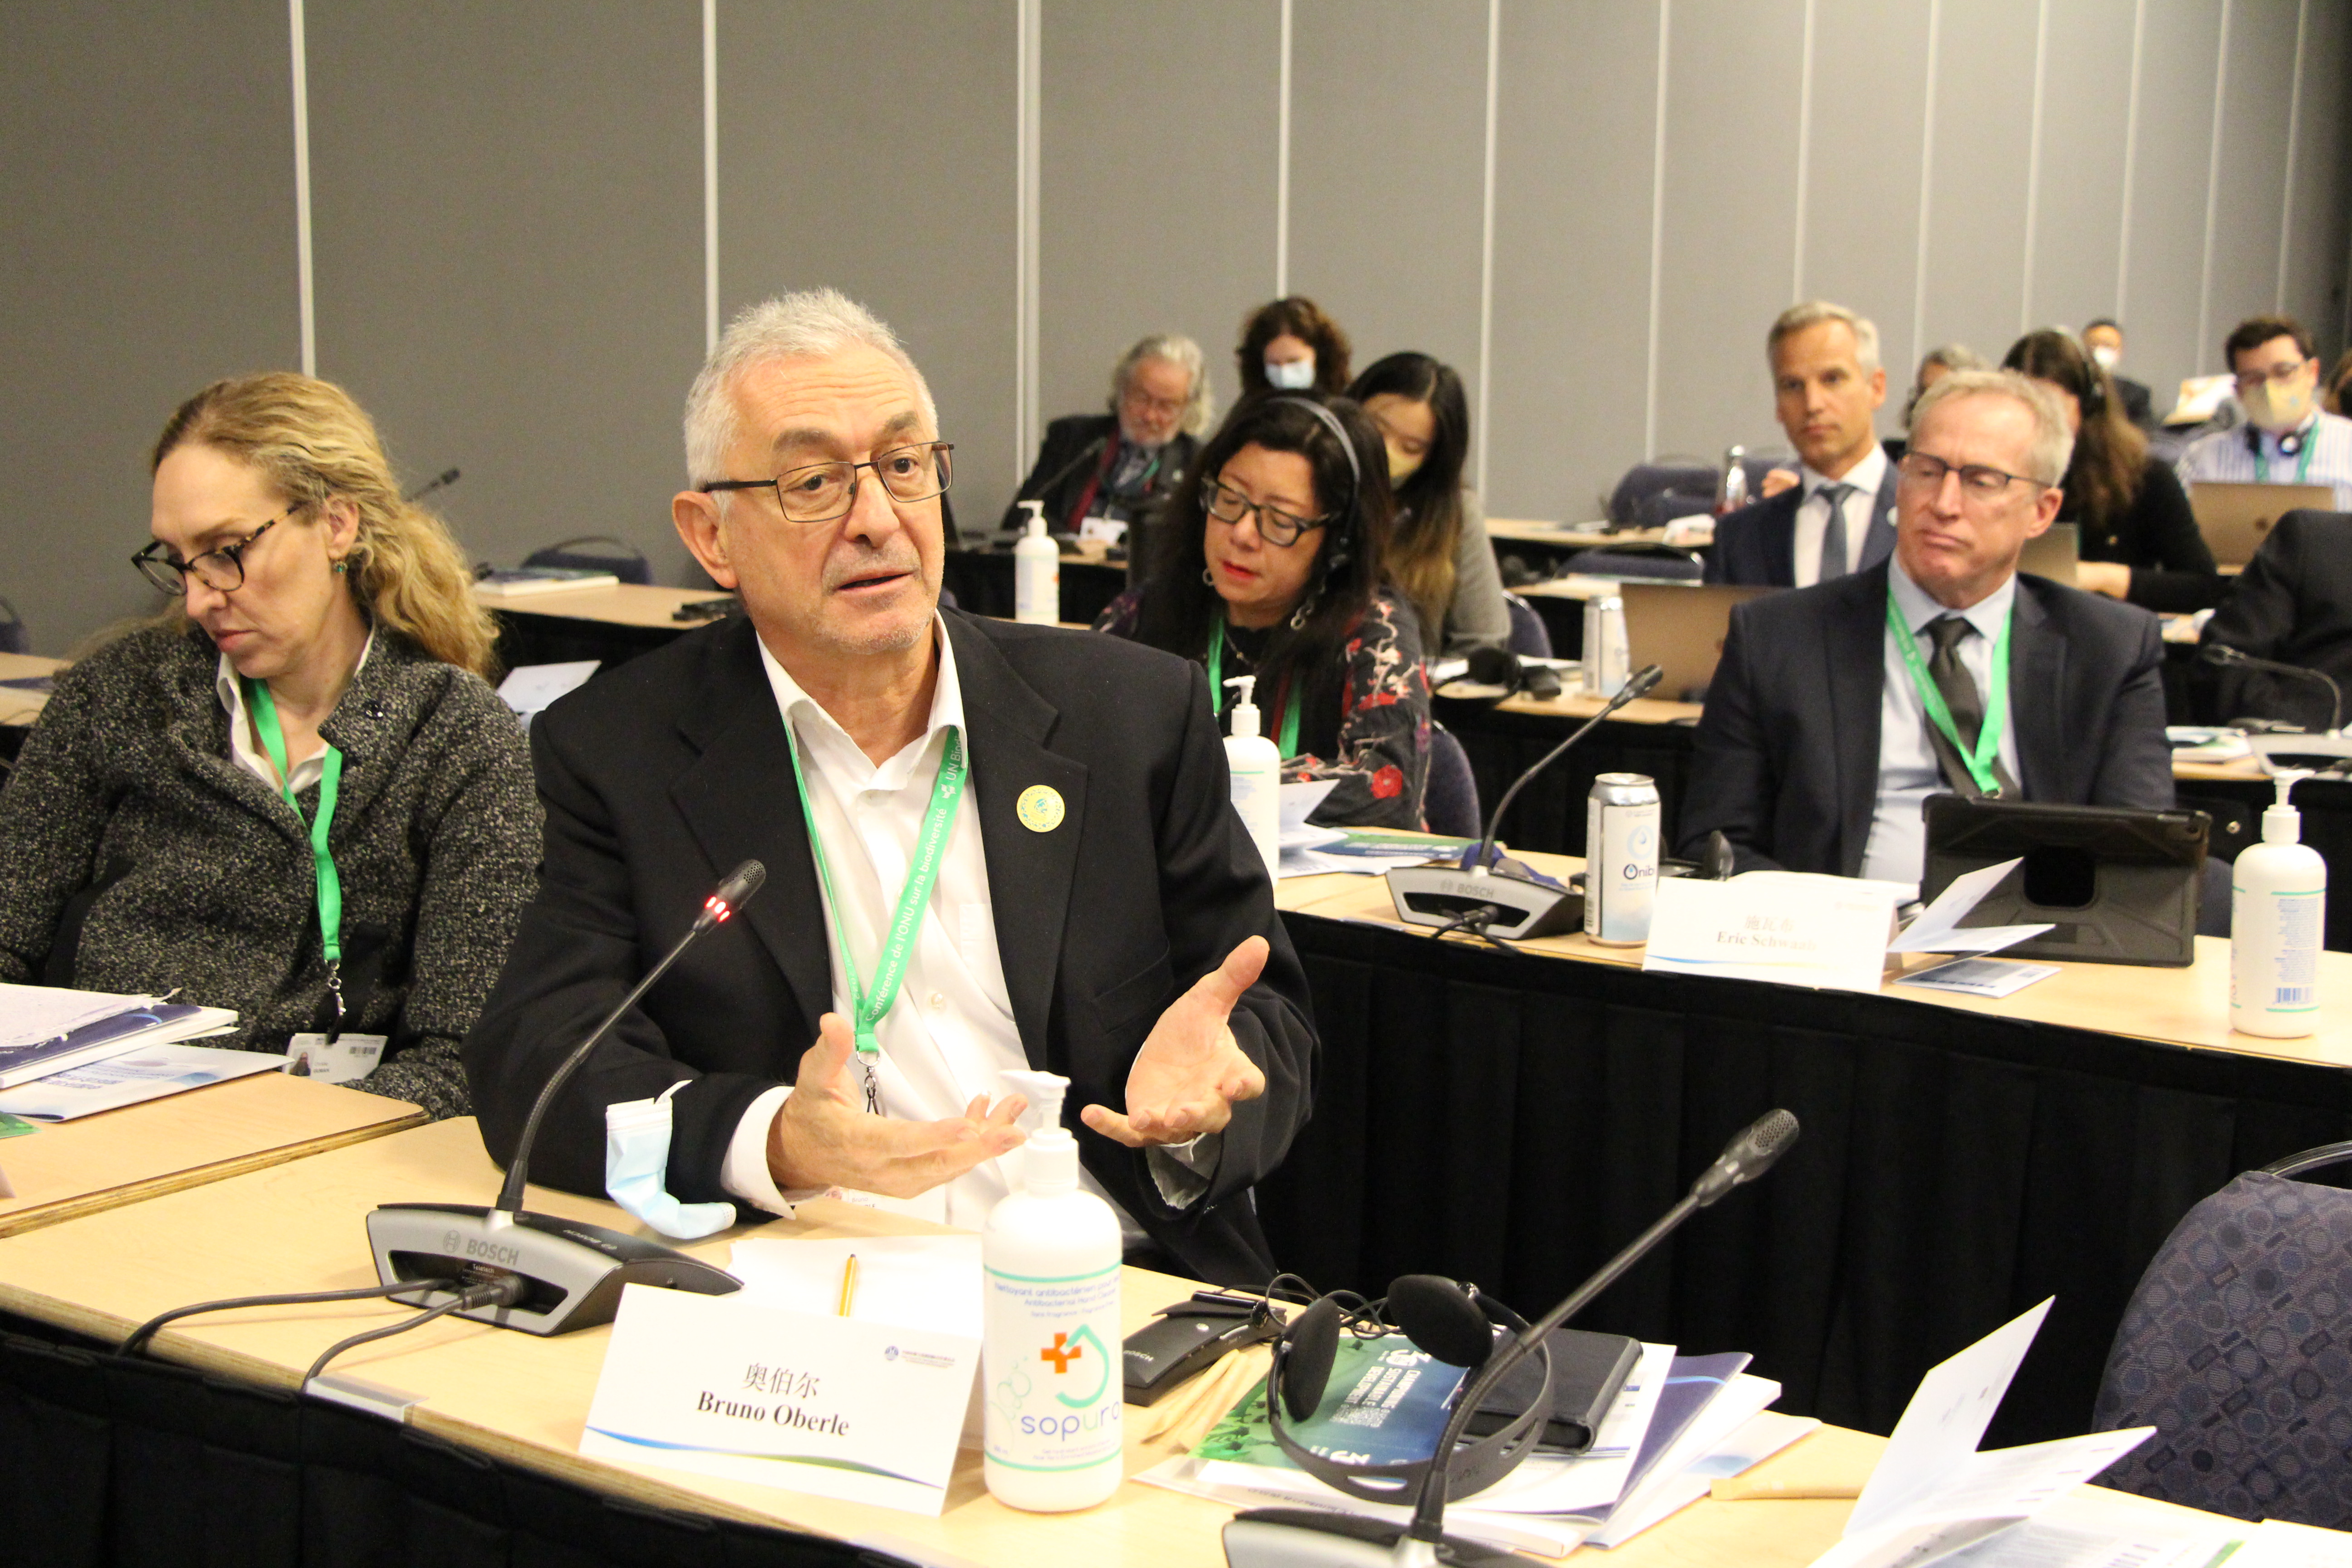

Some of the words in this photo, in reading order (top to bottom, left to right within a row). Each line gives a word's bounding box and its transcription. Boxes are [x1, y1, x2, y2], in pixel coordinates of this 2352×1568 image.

[946, 763, 959, 780] UN
[921, 808, 947, 872] biodiversité
[916, 874, 926, 885] la
[911, 885, 921, 906] sur
[1457, 883, 1494, 898] BOSCH
[895, 907, 915, 941] l'ONU
[1717, 931, 1746, 944] Eric
[893, 941, 903, 958] de
[866, 959, 898, 1021] Conférence
[467, 1240, 519, 1266] BOSCH
[472, 1263, 495, 1273] Teletech
[740, 1362, 820, 1399] 奥伯尔
[697, 1390, 766, 1421] Bruno
[774, 1405, 849, 1436] Oberle
